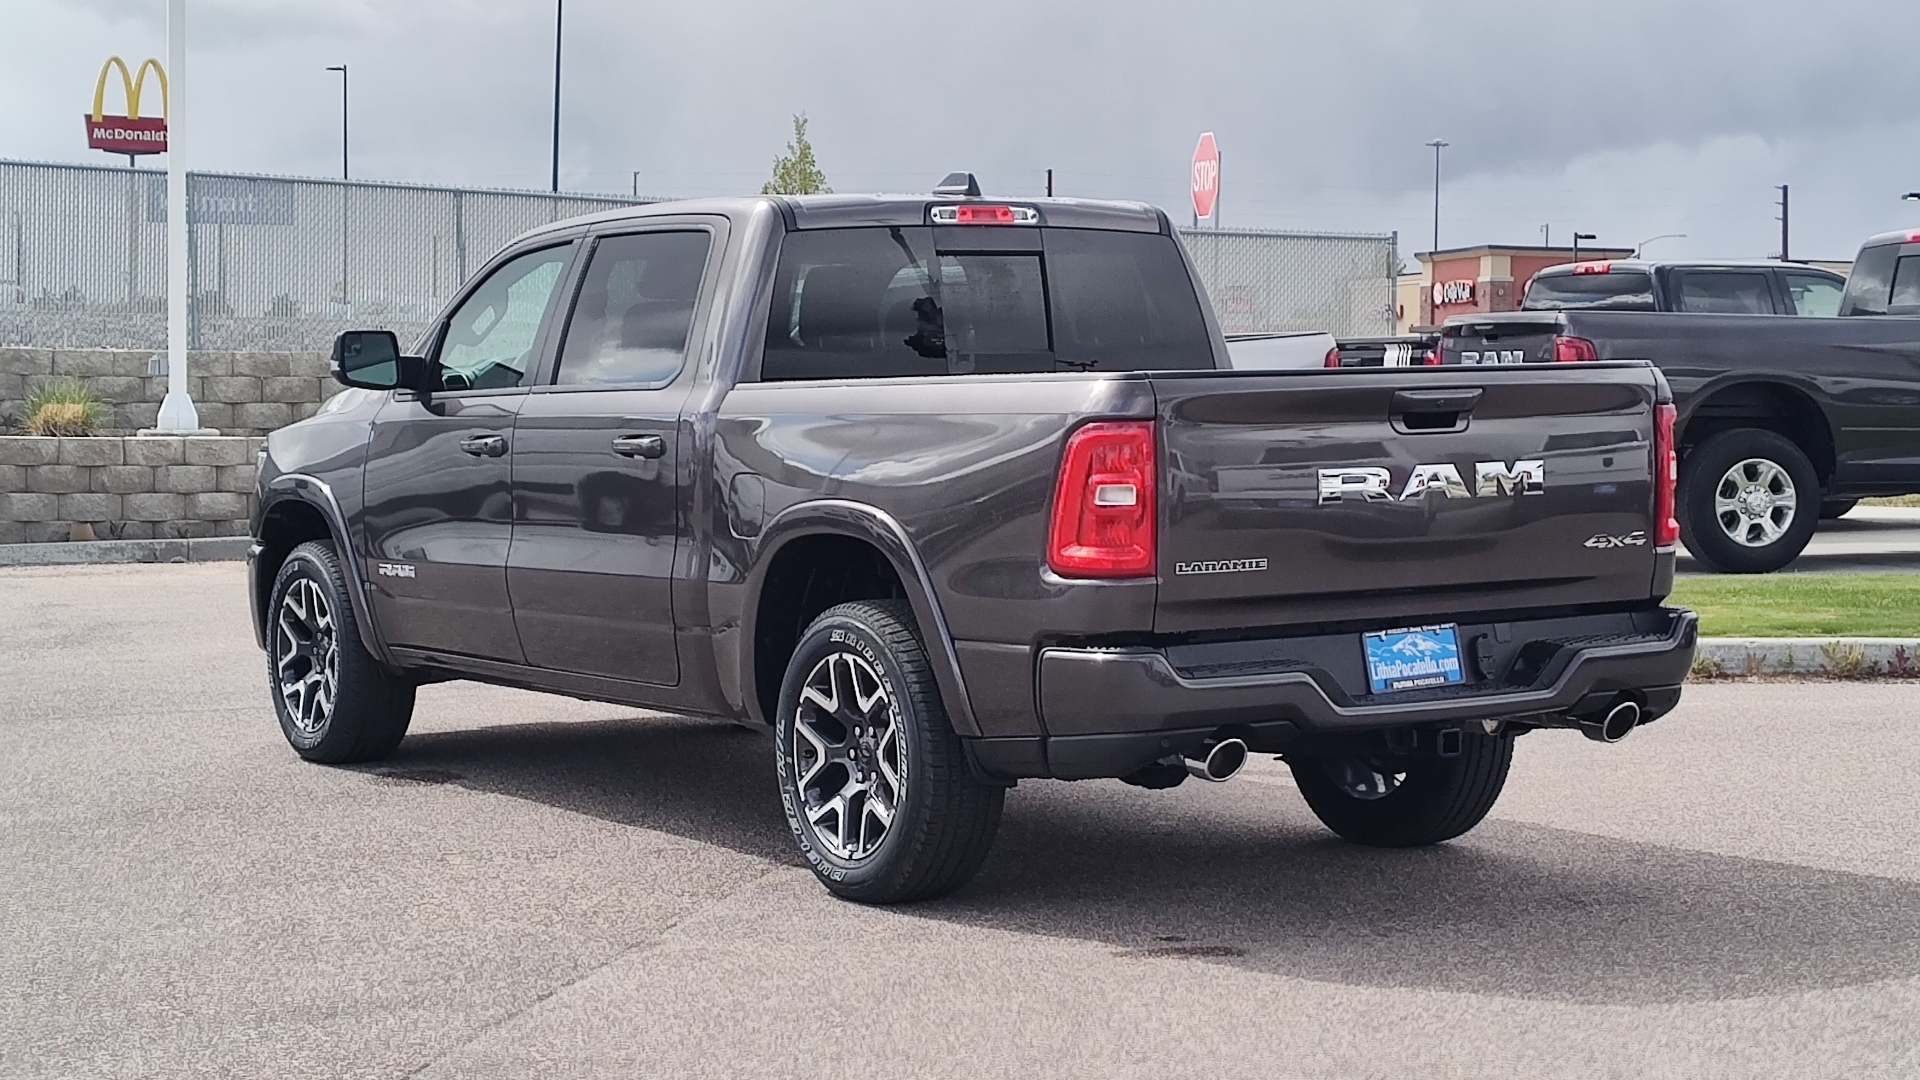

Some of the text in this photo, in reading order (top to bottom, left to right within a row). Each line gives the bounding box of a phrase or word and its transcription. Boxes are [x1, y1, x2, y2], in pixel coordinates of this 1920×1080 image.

[1193, 159, 1217, 192] STOP
[1317, 459, 1545, 505] RAM
[378, 563, 416, 578] RAM
[1175, 558, 1268, 575] LARAMIE
[1370, 656, 1459, 680] LithiaPocatello.com
